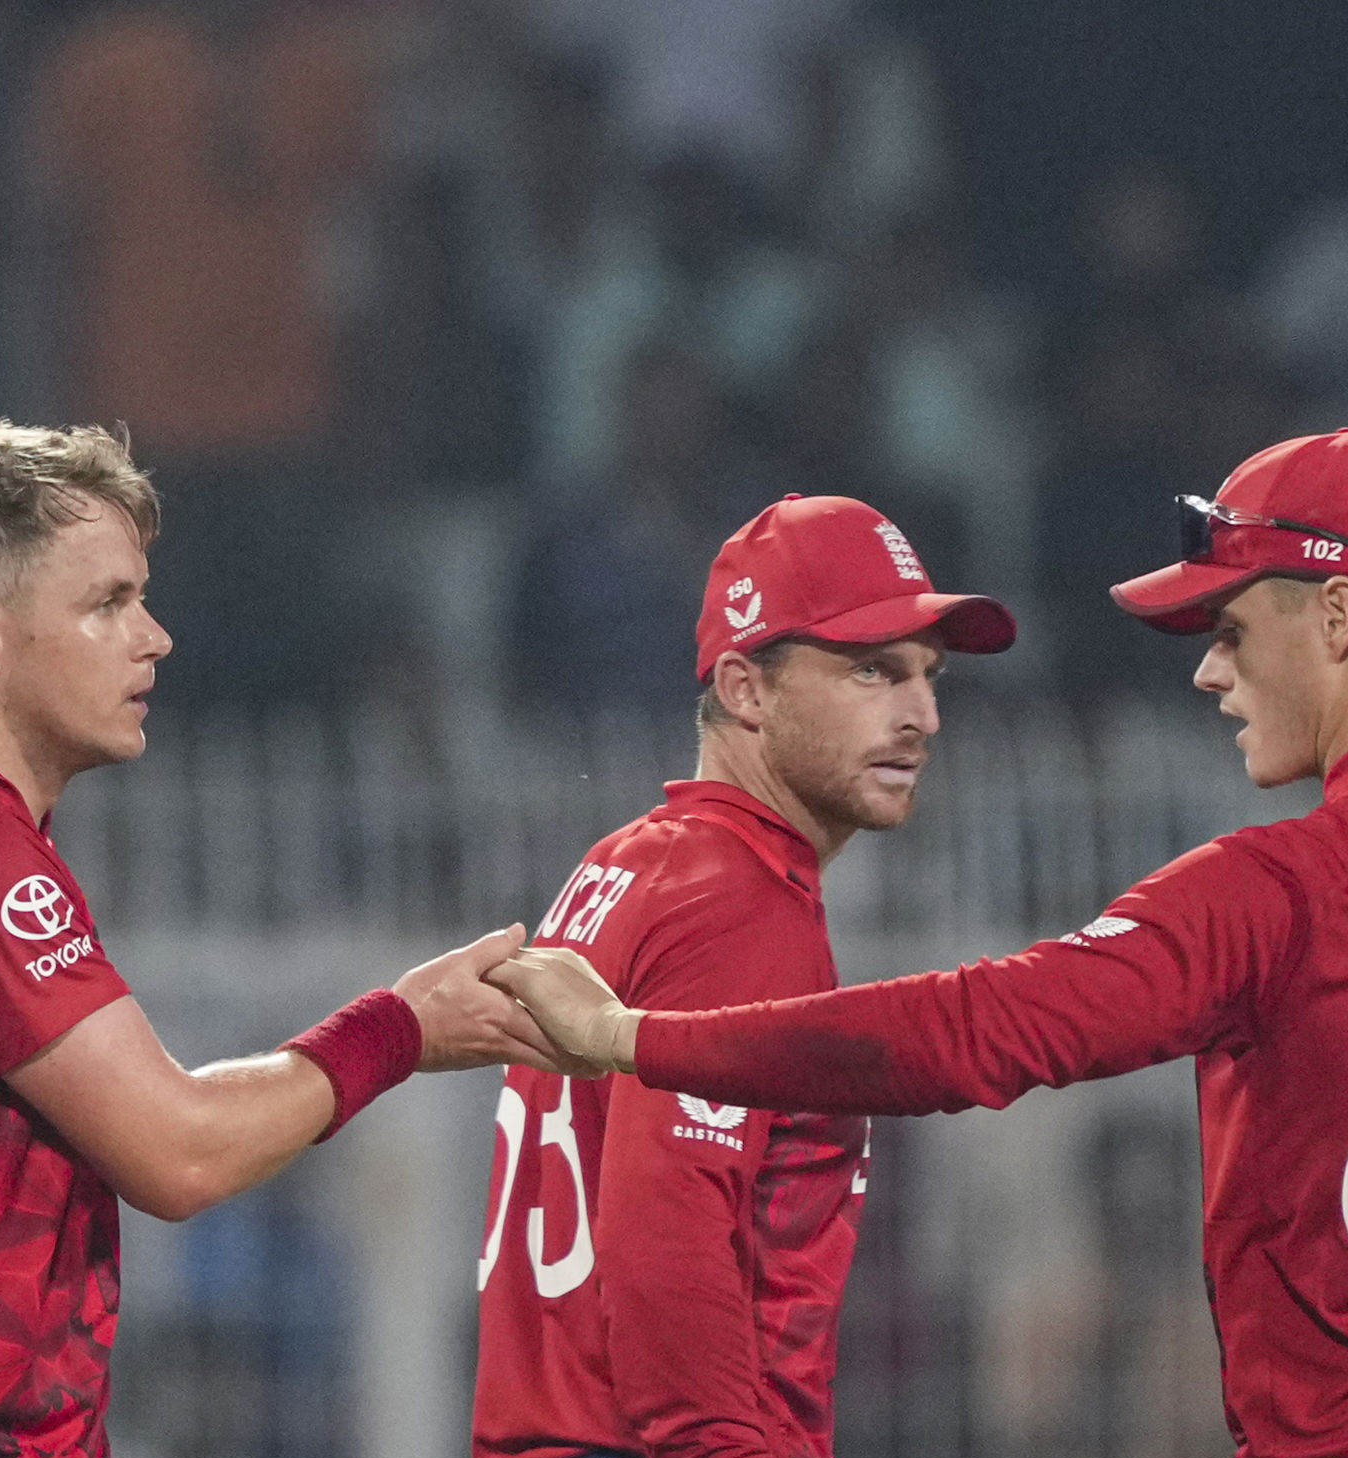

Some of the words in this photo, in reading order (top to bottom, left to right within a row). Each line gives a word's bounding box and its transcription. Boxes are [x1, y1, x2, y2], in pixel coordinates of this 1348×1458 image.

[1301, 538, 1345, 562] 102
[726, 577, 753, 602] 150
[25, 934, 93, 982] TOYOTA
[673, 1125, 744, 1152] CASTORE
